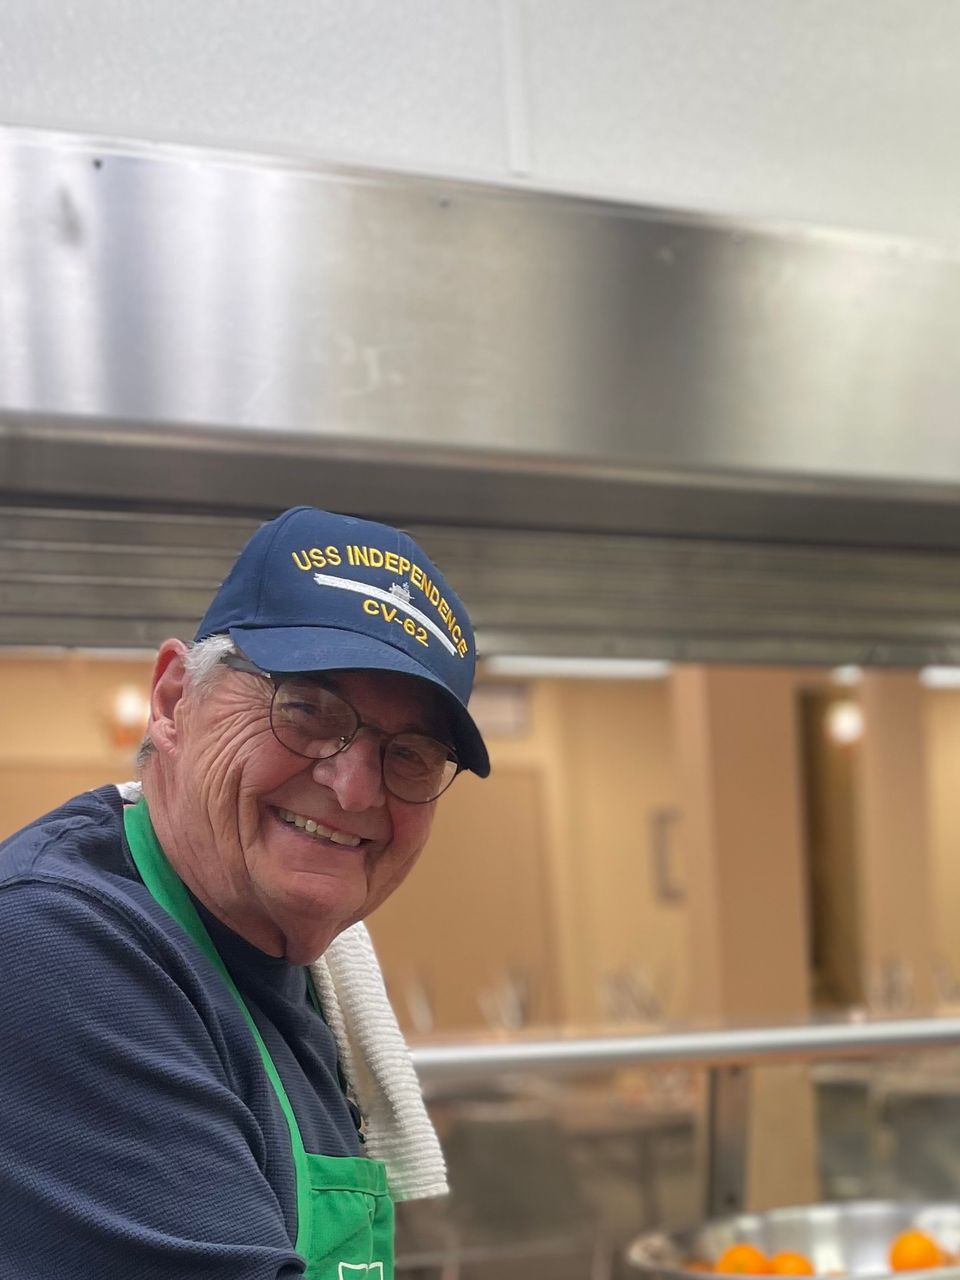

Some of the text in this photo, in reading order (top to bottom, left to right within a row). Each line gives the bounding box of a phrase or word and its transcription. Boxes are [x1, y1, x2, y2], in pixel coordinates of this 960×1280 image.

[292, 545, 468, 658] USS INDEPENDENCE
[363, 599, 429, 647] CV-62
